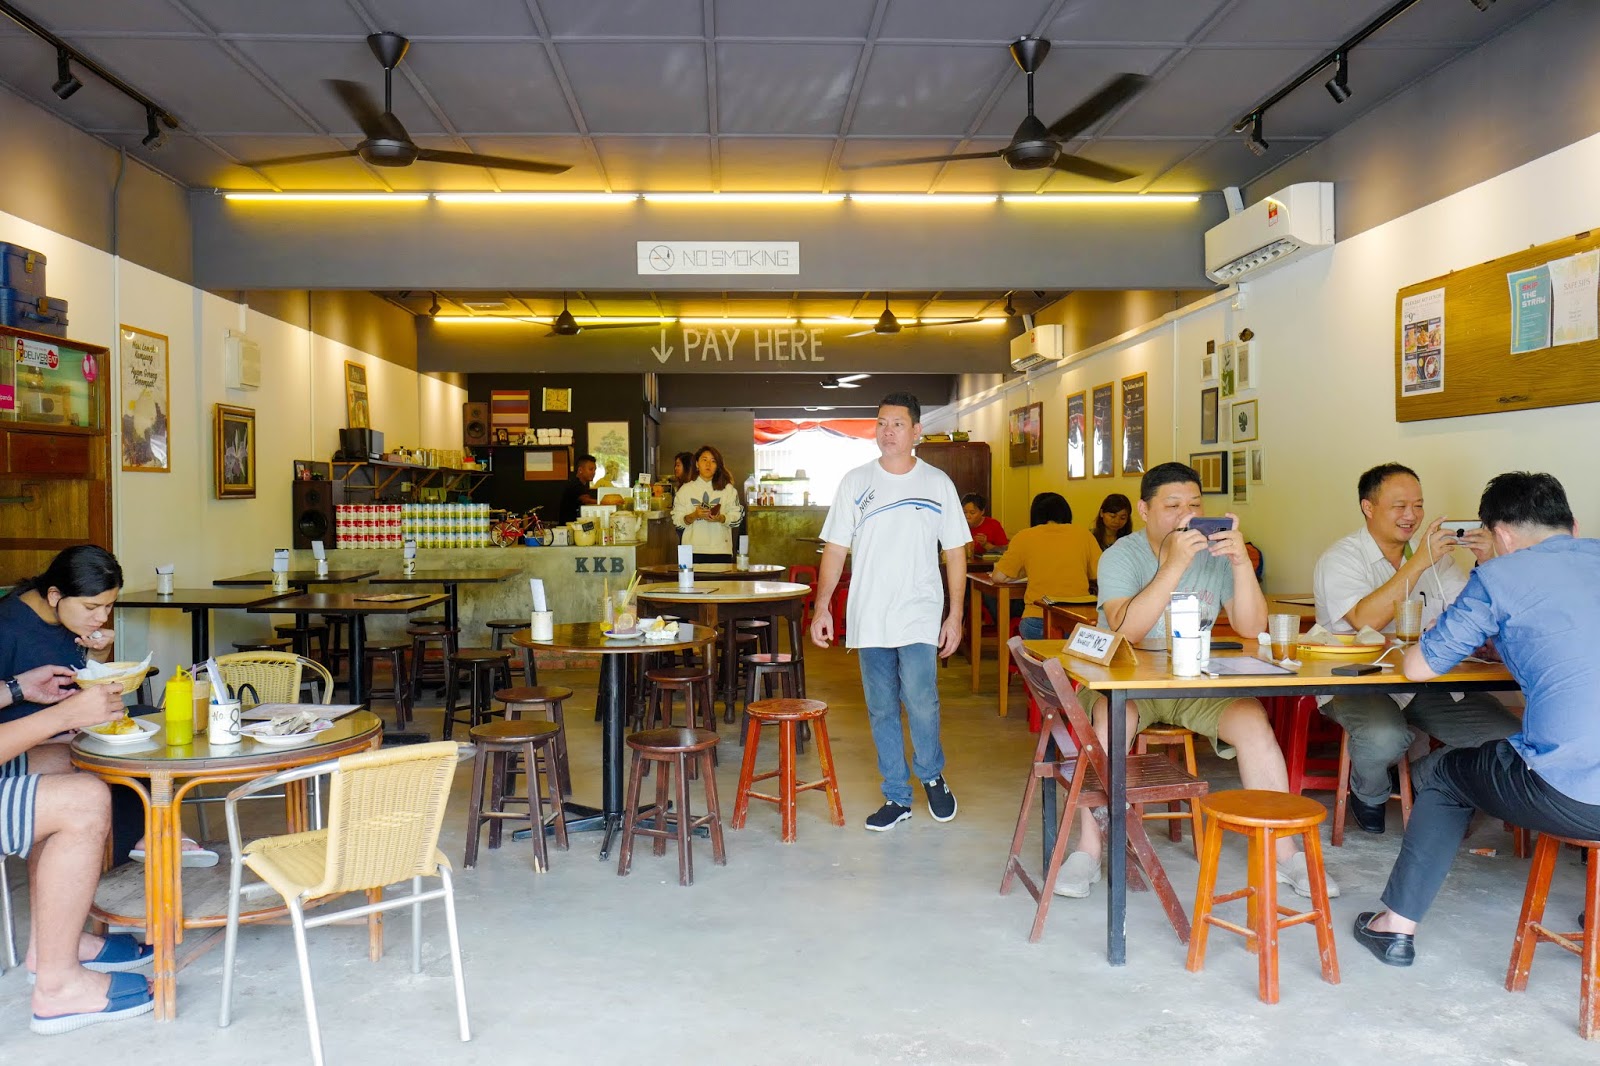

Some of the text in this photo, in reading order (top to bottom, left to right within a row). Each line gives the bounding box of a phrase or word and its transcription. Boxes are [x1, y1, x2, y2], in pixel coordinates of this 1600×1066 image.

[682, 249, 789, 267] NO SMOKING
[1521, 281, 1539, 292] SKIP
[1521, 290, 1537, 300] THE
[1521, 296, 1547, 308] STRAW
[683, 328, 825, 362] PAY HERE
[859, 489, 876, 510] NIKE
[410, 561, 416, 573] 2
[228, 707, 241, 736] 8
